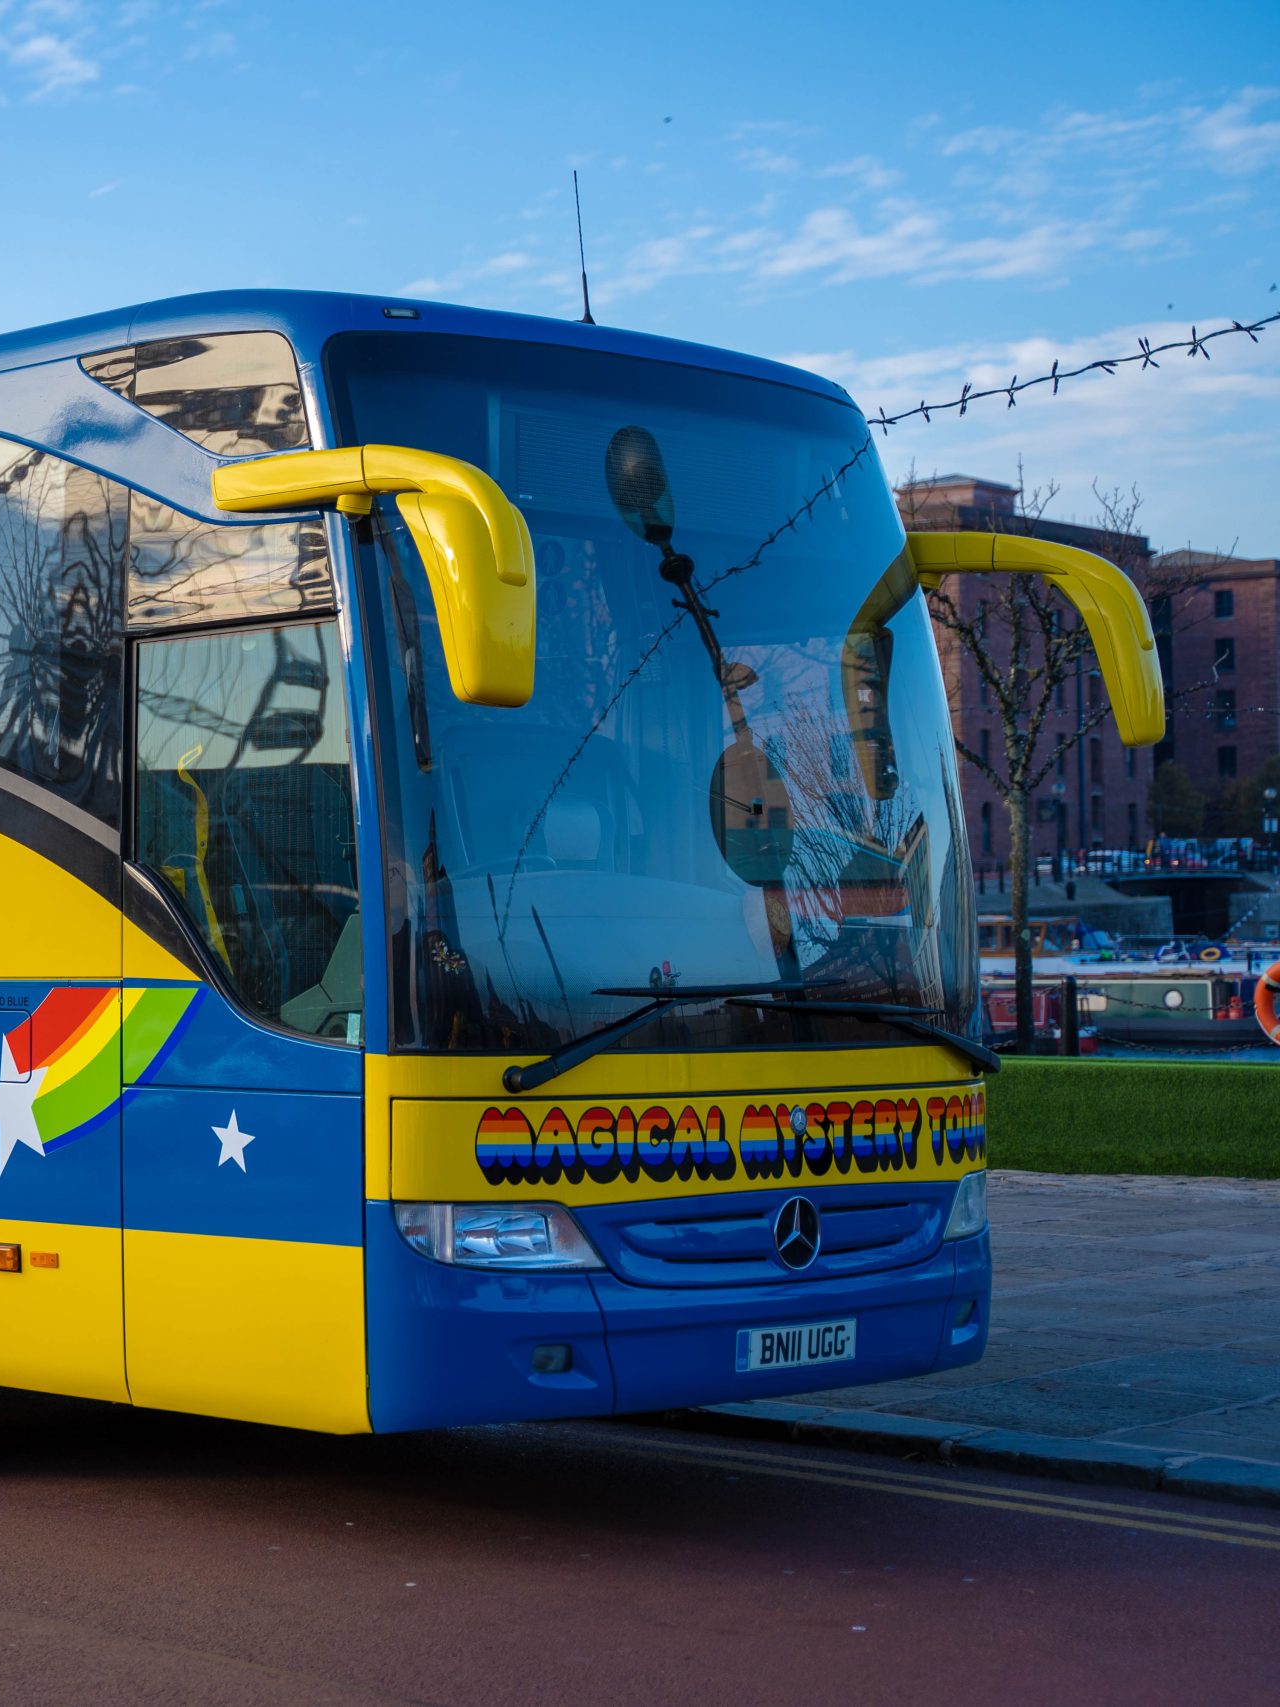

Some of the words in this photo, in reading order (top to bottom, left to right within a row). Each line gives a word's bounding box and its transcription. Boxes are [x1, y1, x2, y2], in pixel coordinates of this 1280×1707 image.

[7, 996, 30, 1007] BLUE
[474, 1104, 738, 1187] MAGICAL
[739, 1097, 923, 1181] MYSTERY
[807, 1324, 846, 1359] UGG
